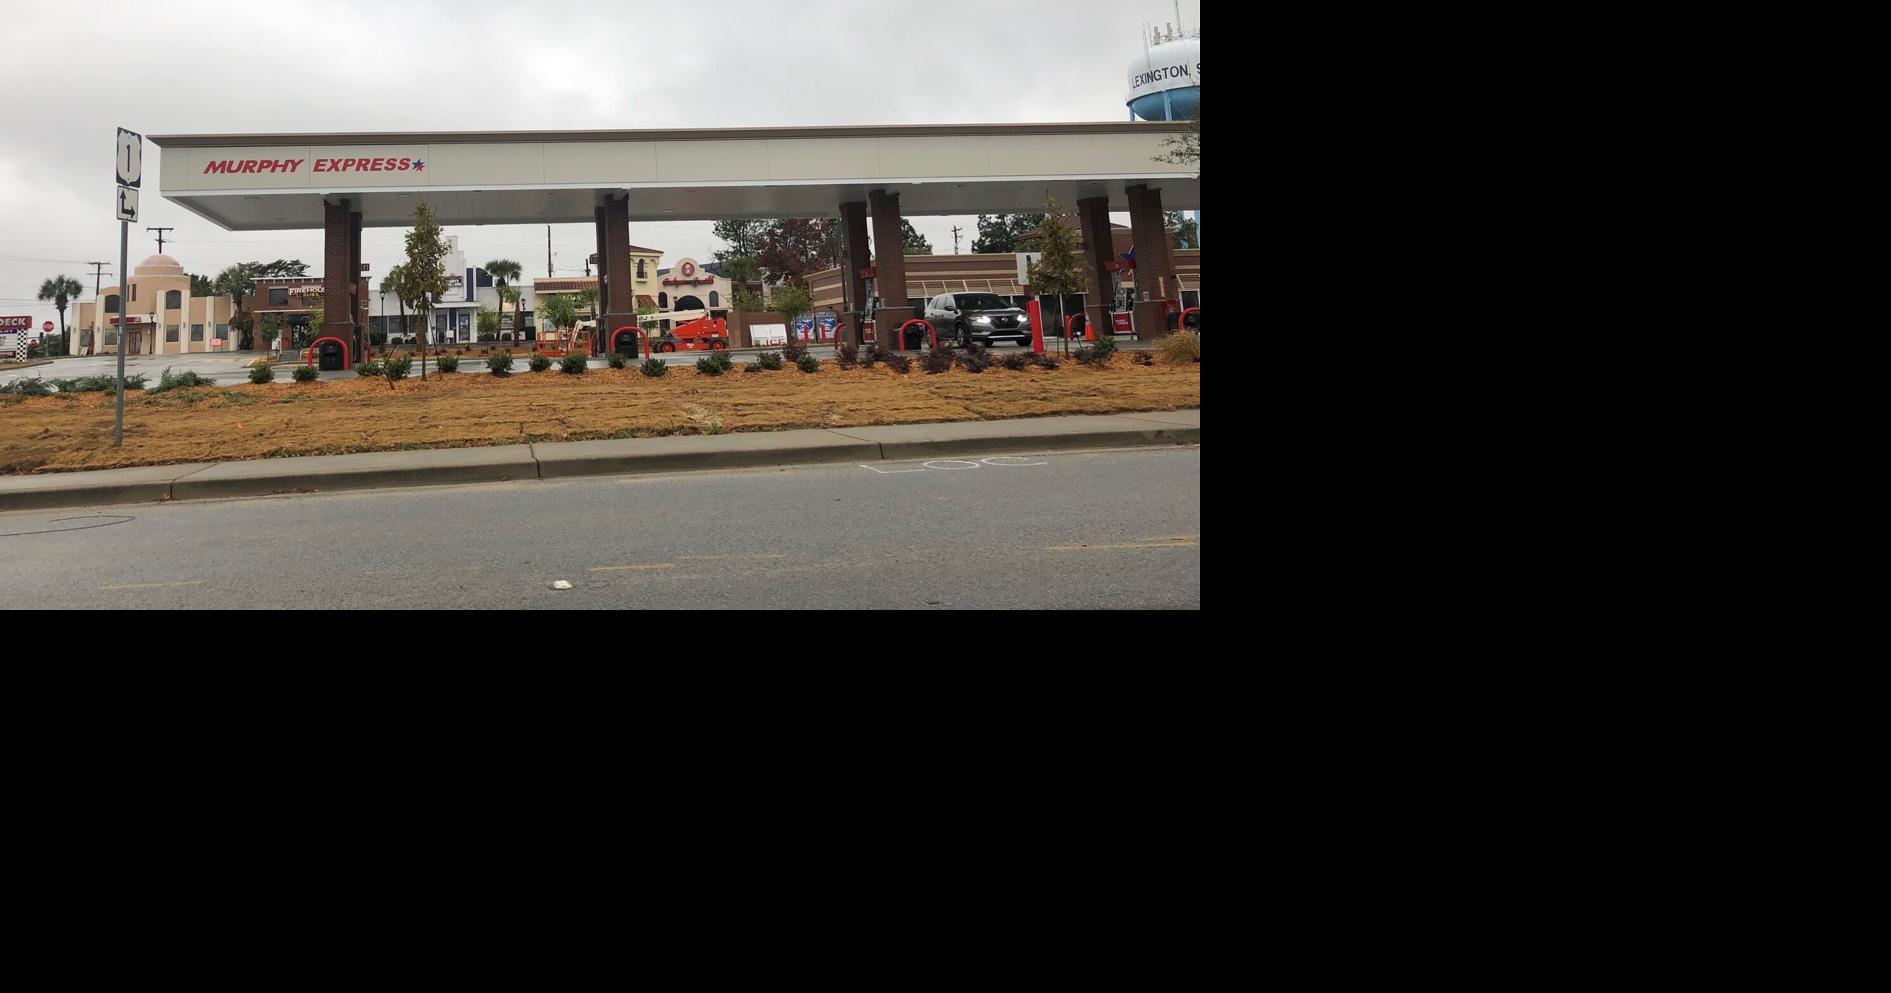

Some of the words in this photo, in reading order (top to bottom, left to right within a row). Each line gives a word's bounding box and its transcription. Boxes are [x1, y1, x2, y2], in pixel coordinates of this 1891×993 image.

[1131, 64, 1191, 89] LEXINGTON,
[126, 144, 131, 173] 1
[203, 159, 305, 174] MURPHY
[313, 158, 412, 173] EXPRESS
